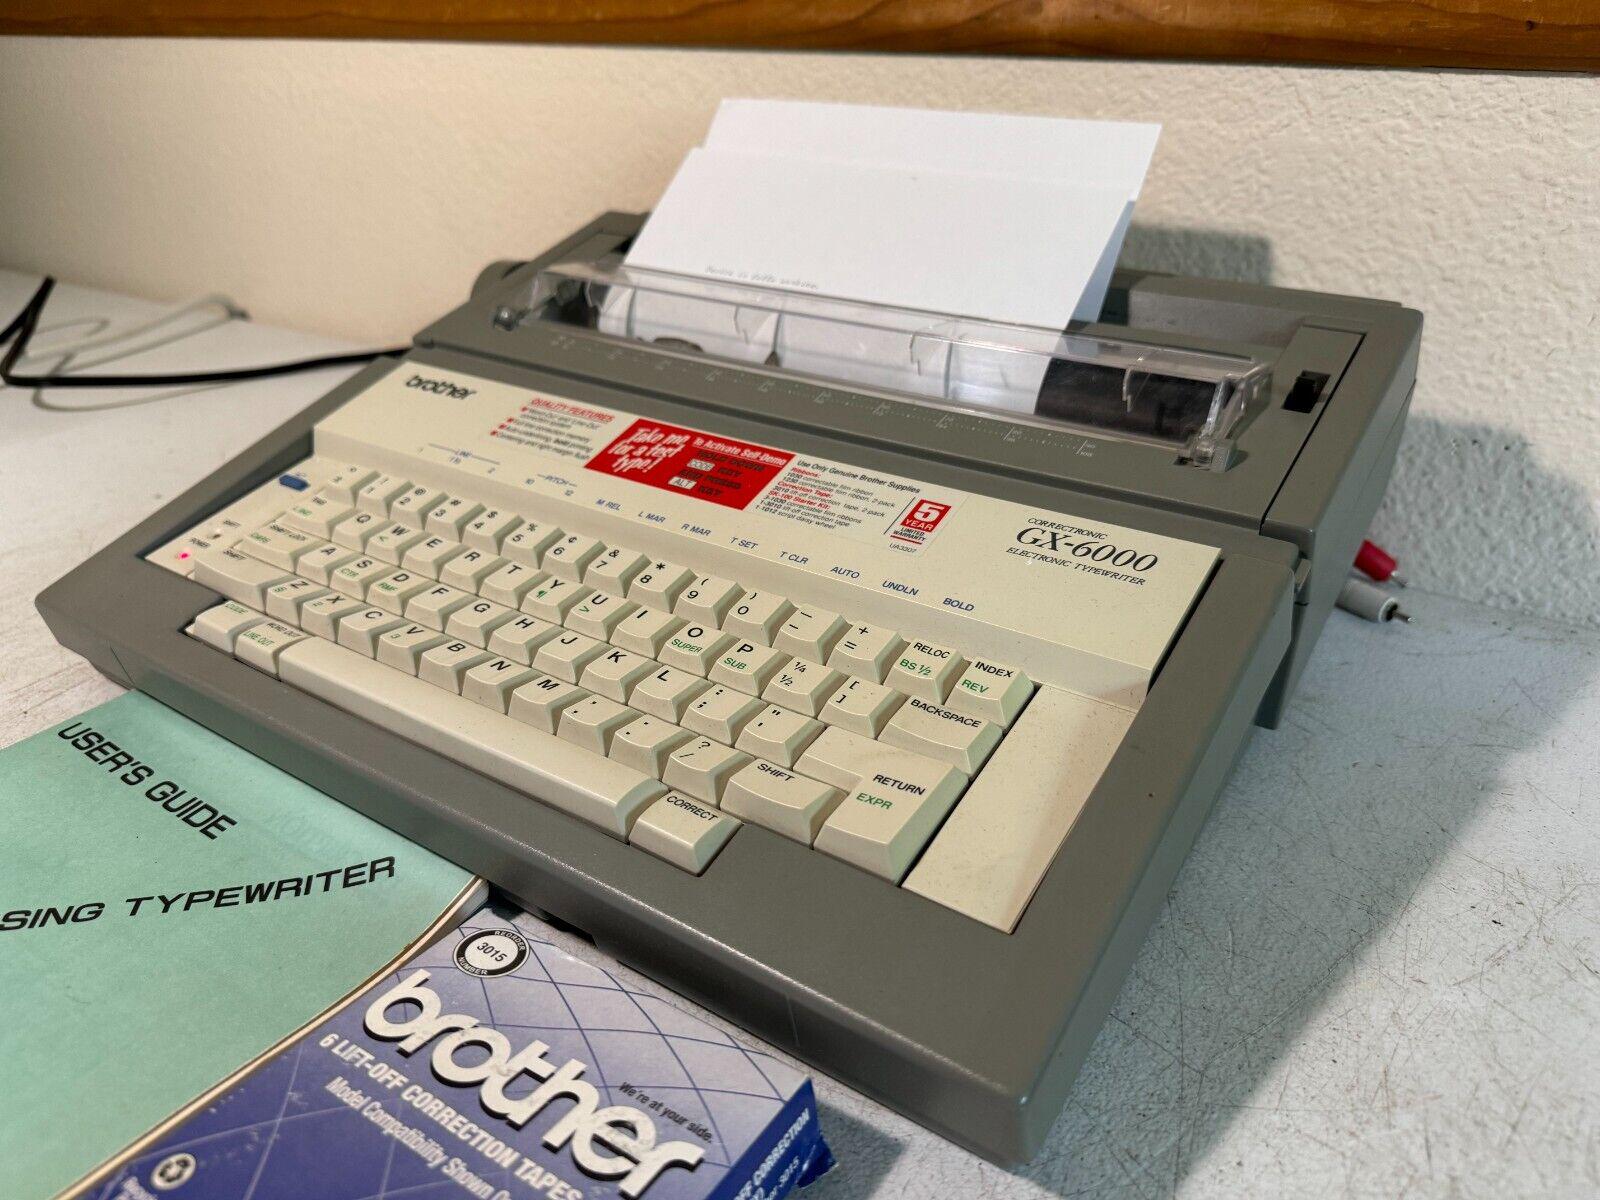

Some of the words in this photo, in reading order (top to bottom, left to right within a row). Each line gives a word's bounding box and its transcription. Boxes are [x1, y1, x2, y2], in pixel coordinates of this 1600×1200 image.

[406, 375, 477, 400] brother
[628, 427, 666, 444] Take
[662, 433, 691, 446] me
[607, 441, 634, 455] for
[705, 440, 741, 455] Activate
[674, 478, 691, 488] ALT
[810, 464, 828, 472] Only
[828, 468, 859, 478] Genuine
[859, 475, 887, 485] Brother
[886, 482, 920, 494] Supplies
[777, 481, 812, 493] Correction
[604, 501, 622, 512] REL
[913, 501, 945, 523] 5
[356, 513, 372, 524] Q
[434, 509, 447, 518] 3
[487, 510, 498, 520] $
[646, 513, 667, 524] MAR
[473, 521, 485, 530] 4
[527, 522, 538, 533] %
[905, 518, 934, 531] YEAR
[1027, 517, 1108, 540] CORRECTRONIC
[392, 525, 411, 537] W
[689, 525, 712, 537] MAR
[893, 530, 926, 541] WARRANTY
[900, 527, 925, 536] LIMITED
[427, 538, 444, 549] E
[512, 534, 525, 543] 5
[738, 539, 759, 550] SET
[321, 546, 337, 556] A
[553, 546, 565, 556] 6
[608, 549, 620, 558] &
[1016, 527, 1158, 572] GX-6000
[464, 551, 481, 562] R
[788, 553, 809, 565] CLR
[357, 559, 373, 569] S
[507, 564, 523, 575] T
[596, 560, 608, 569] 7
[1005, 546, 1072, 568] ELECTRONIC
[1074, 562, 1146, 586] TYPEWRITER
[393, 573, 410, 583] D
[830, 566, 860, 579] AUTO
[290, 580, 309, 589] Z
[549, 579, 565, 590] Y
[640, 574, 652, 584] 8
[431, 587, 450, 597] F
[882, 580, 920, 596] UNDLN
[326, 595, 346, 604] X
[590, 594, 608, 606] U
[687, 590, 699, 600] 9
[474, 602, 491, 614] G
[942, 597, 975, 612] BOLD
[365, 610, 383, 619] C
[636, 610, 649, 619] I
[515, 618, 535, 629] H
[406, 626, 425, 635] V
[687, 627, 704, 638] O
[858, 626, 869, 635] +
[243, 630, 261, 641] LINE
[257, 637, 275, 647] OUT
[560, 636, 578, 646] J
[447, 642, 466, 653] B
[671, 638, 703, 653] SUPER
[736, 643, 754, 655] P
[844, 640, 857, 650] =
[913, 642, 950, 659] RELOC
[607, 651, 627, 663] K
[490, 660, 512, 671] N
[723, 657, 747, 671] SUB
[899, 658, 916, 670] BS
[974, 661, 1015, 678] INDEX
[656, 669, 670, 681] L
[536, 678, 560, 691] M
[849, 680, 860, 690] [
[961, 679, 989, 694] REV
[835, 693, 847, 704] ]
[910, 699, 982, 728] BACKSPACE
[698, 741, 711, 749] ?
[757, 763, 796, 782] SHIFT
[57, 721, 155, 787] USER'S
[145, 780, 238, 841] GUIDE
[872, 773, 926, 796] RETURN
[856, 792, 894, 811] EXPR
[666, 795, 719, 822] CORRECT
[0, 902, 106, 931] SING
[125, 855, 397, 917] TYPEWRITER
[494, 930, 526, 951] REORDER
[476, 941, 508, 962] 3015
[458, 956, 489, 976] NUMBER
[362, 968, 706, 1199] brother
[318, 1033, 340, 1049] 6
[330, 1040, 409, 1091] LIFT-OFF
[401, 1083, 521, 1168] CORRECTION
[514, 1157, 584, 1200] TAPES
[618, 1081, 650, 1106] We're
[648, 1100, 663, 1112] at
[659, 1107, 689, 1127] your
[686, 1120, 713, 1144] side.
[325, 1075, 366, 1109] Model
[360, 1100, 449, 1170] Compatibility
[441, 1156, 495, 1200] Shown
[752, 1107, 810, 1186] CORRECTION
